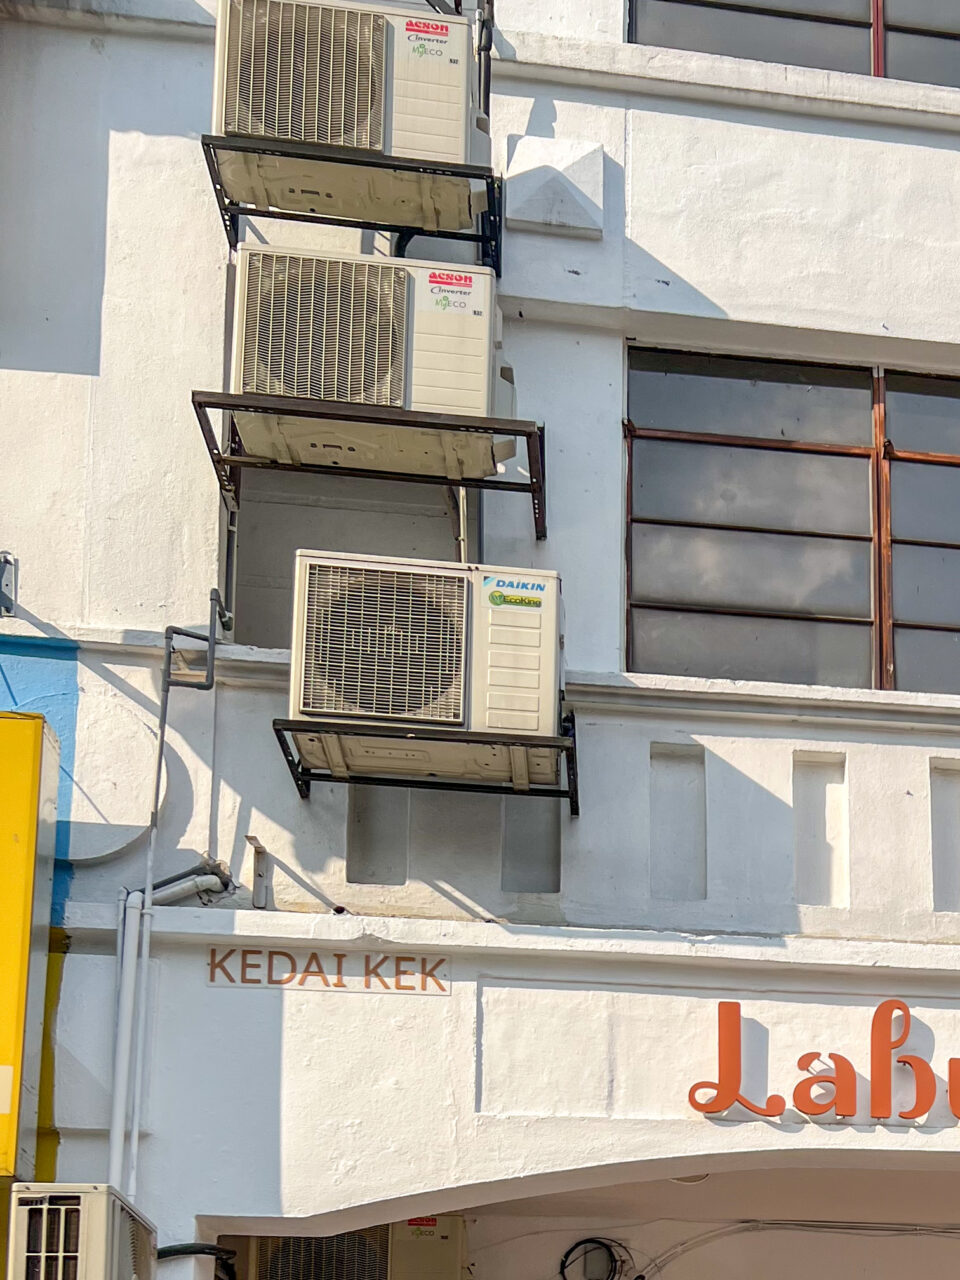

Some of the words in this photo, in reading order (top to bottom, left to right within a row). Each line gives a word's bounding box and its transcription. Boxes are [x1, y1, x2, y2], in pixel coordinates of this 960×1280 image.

[495, 579, 546, 592] DAIKIN
[209, 948, 348, 988] KEDAI
[363, 954, 447, 992] KEK
